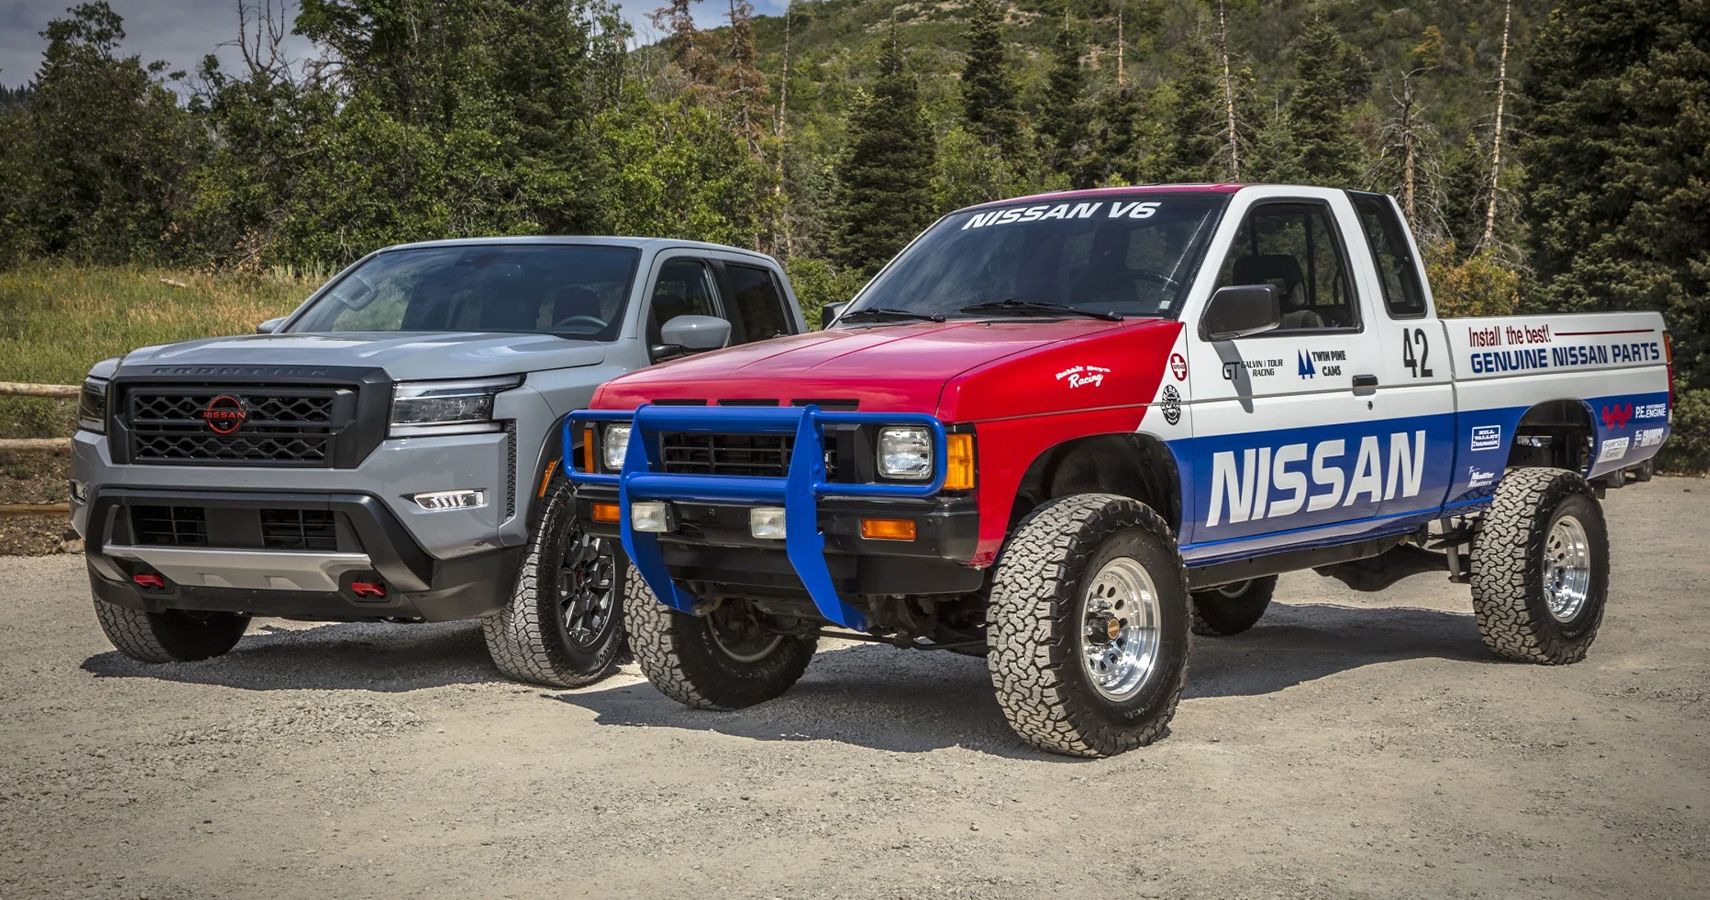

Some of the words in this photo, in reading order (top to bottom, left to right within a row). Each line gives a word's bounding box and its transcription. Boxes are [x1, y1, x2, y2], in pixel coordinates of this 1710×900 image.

[961, 202, 1103, 230] NISSAN
[1108, 202, 1161, 219] V6
[1468, 326, 1502, 347] Install
[1506, 325, 1524, 345] the
[1524, 323, 1552, 344] best!
[1311, 351, 1331, 362] TWIN
[1331, 350, 1347, 361] PINE
[1403, 328, 1433, 378] 42
[1470, 348, 1548, 374] GENUINE
[1552, 345, 1608, 367] NISSAN
[1612, 342, 1660, 363] PARTS
[151, 366, 328, 376] FRONTIER
[1222, 361, 1240, 380] GT
[1240, 360, 1262, 369] GALVIN
[1267, 359, 1283, 368] TOUR
[1322, 365, 1341, 377] CAMS
[1252, 368, 1275, 377] RACING
[1068, 372, 1104, 389] Racing
[203, 411, 247, 420] NISSAN
[1646, 408, 1666, 419] ENGINE
[1206, 430, 1426, 527] NISSAN
